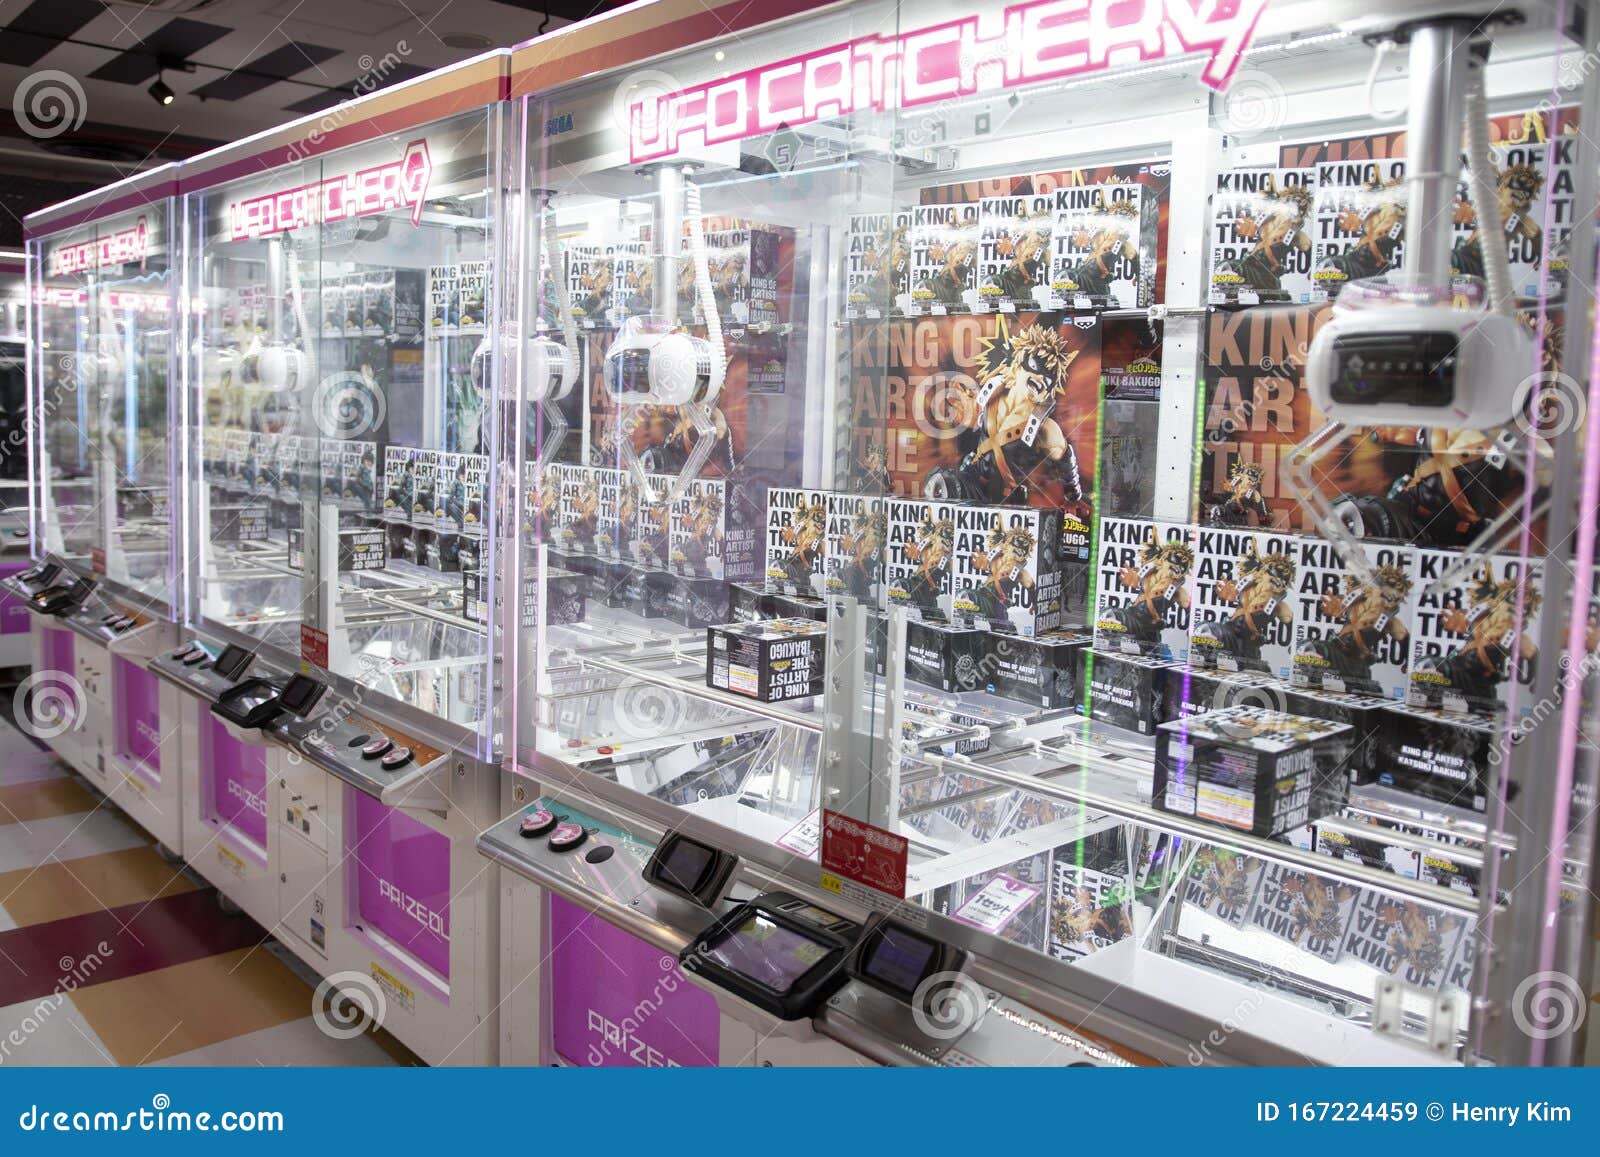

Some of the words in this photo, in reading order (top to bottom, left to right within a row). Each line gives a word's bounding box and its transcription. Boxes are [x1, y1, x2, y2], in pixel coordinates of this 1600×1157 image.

[630, 77, 752, 164] UFO
[757, 0, 1166, 129] CATCHER
[230, 197, 281, 241] UFO
[279, 160, 409, 232] CATCHER
[853, 317, 939, 369] KING
[769, 639, 807, 661] BAKUGO
[791, 657, 810, 671] THE
[769, 669, 811, 688] ARTIST
[785, 681, 811, 698] KING
[768, 687, 784, 701] OF
[975, 893, 1012, 915] 1セット
